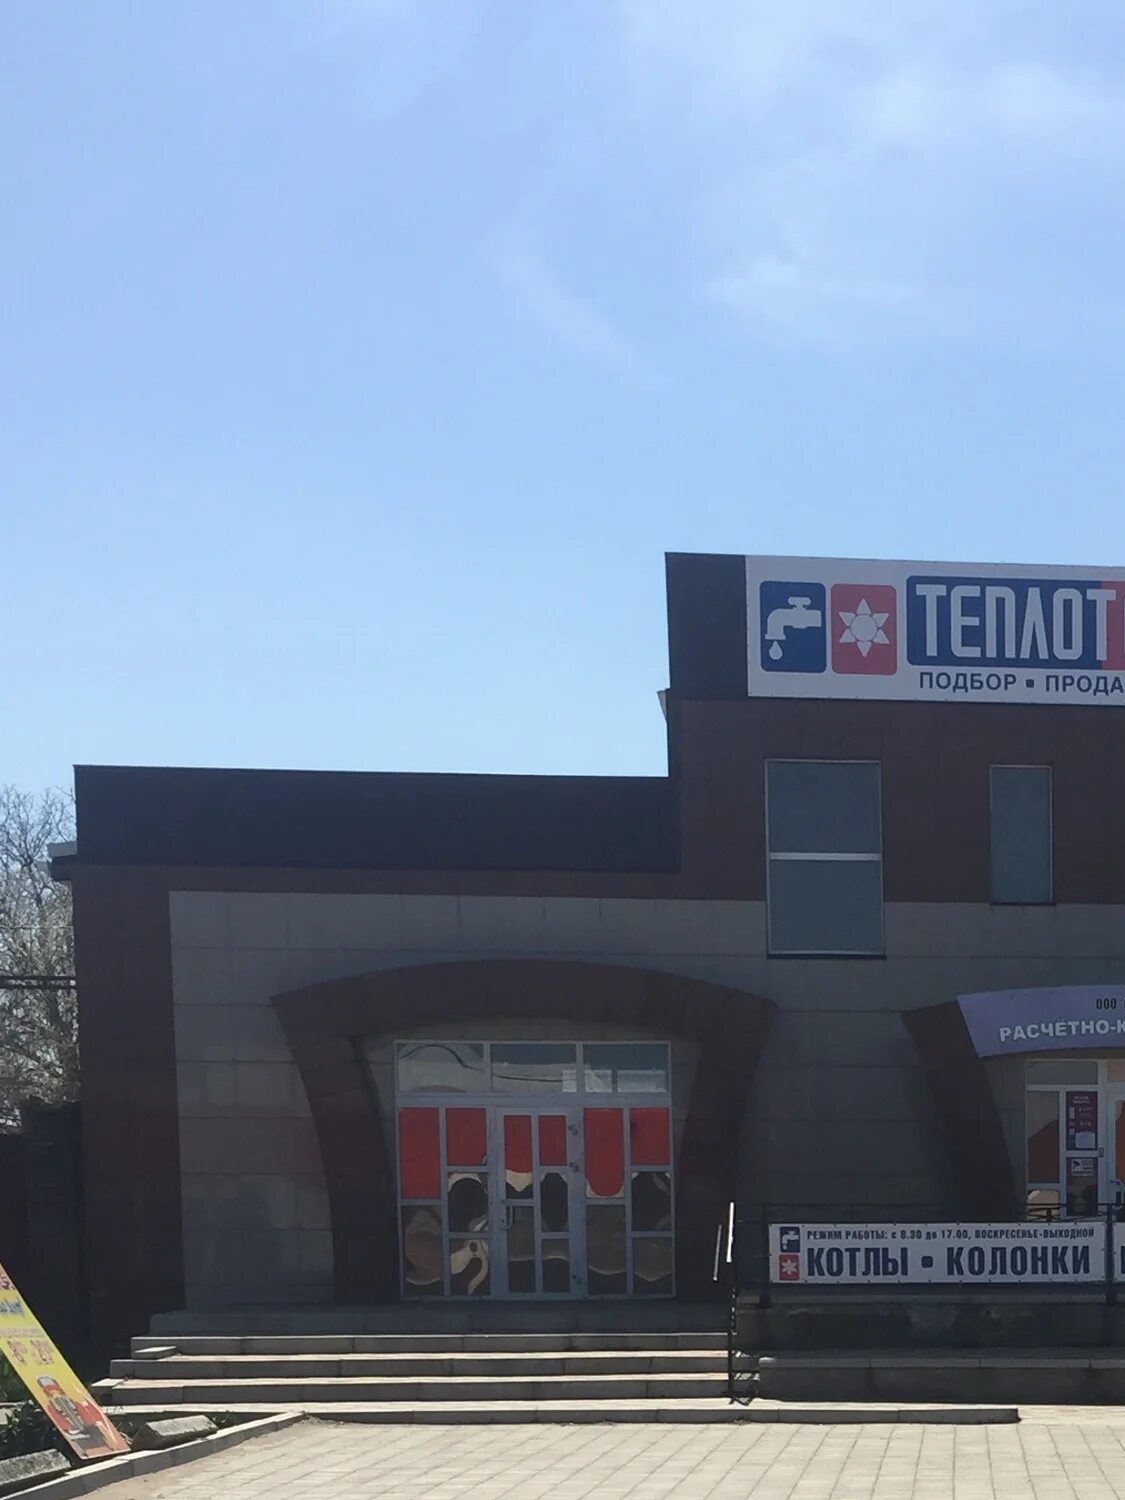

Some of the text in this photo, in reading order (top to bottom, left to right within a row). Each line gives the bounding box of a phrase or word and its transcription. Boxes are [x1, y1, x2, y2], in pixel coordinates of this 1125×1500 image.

[919, 671, 1017, 693] ПОДБОР
[807, 1230, 842, 1240] РЕЖИМ
[845, 1229, 888, 1240] РАБОТЫ:
[807, 1245, 1091, 1276] КОТЛЫ КОЛОНКИ
